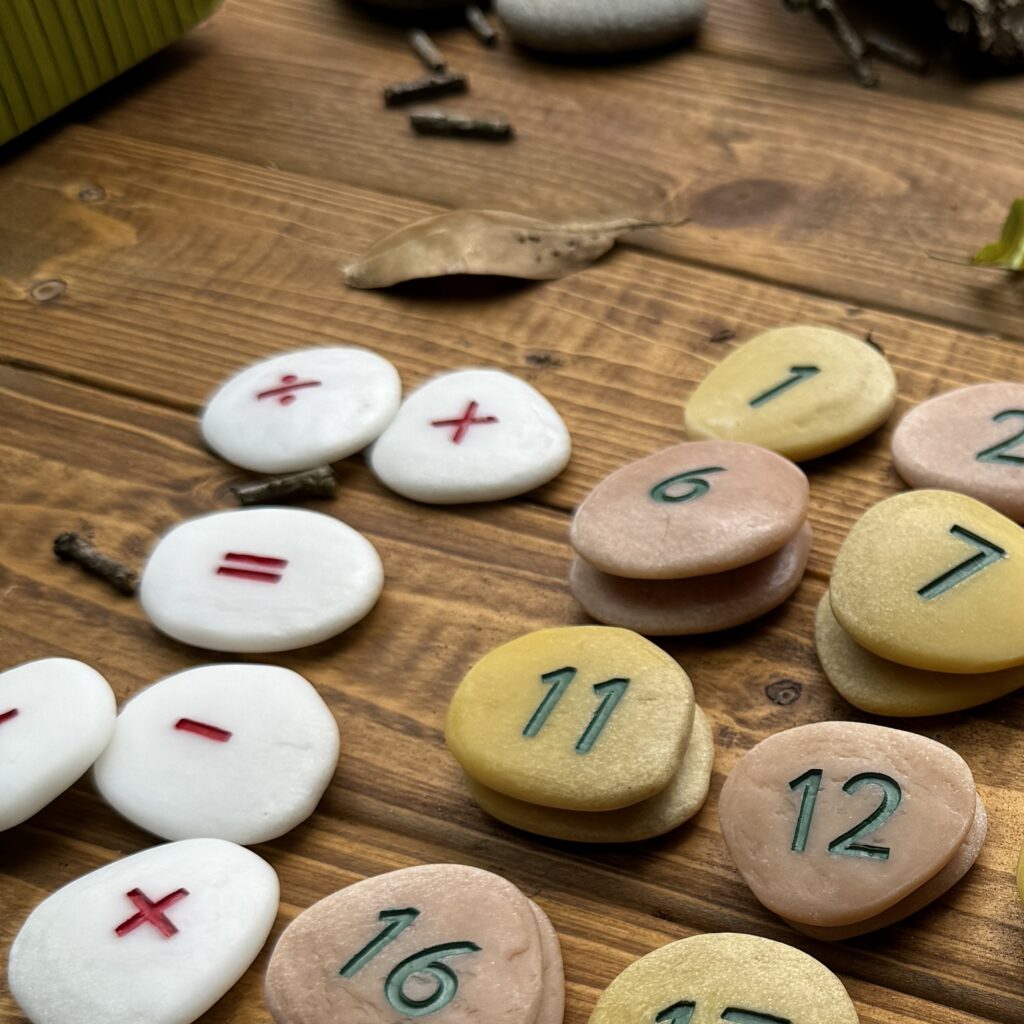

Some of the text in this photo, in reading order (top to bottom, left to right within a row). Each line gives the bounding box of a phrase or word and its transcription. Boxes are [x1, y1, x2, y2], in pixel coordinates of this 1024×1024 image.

[750, 365, 821, 406] 1
[649, 466, 726, 504] 6
[917, 524, 1006, 599] 7
[522, 666, 631, 755] 11
[788, 768, 902, 860] 12
[338, 907, 482, 1012] 16
